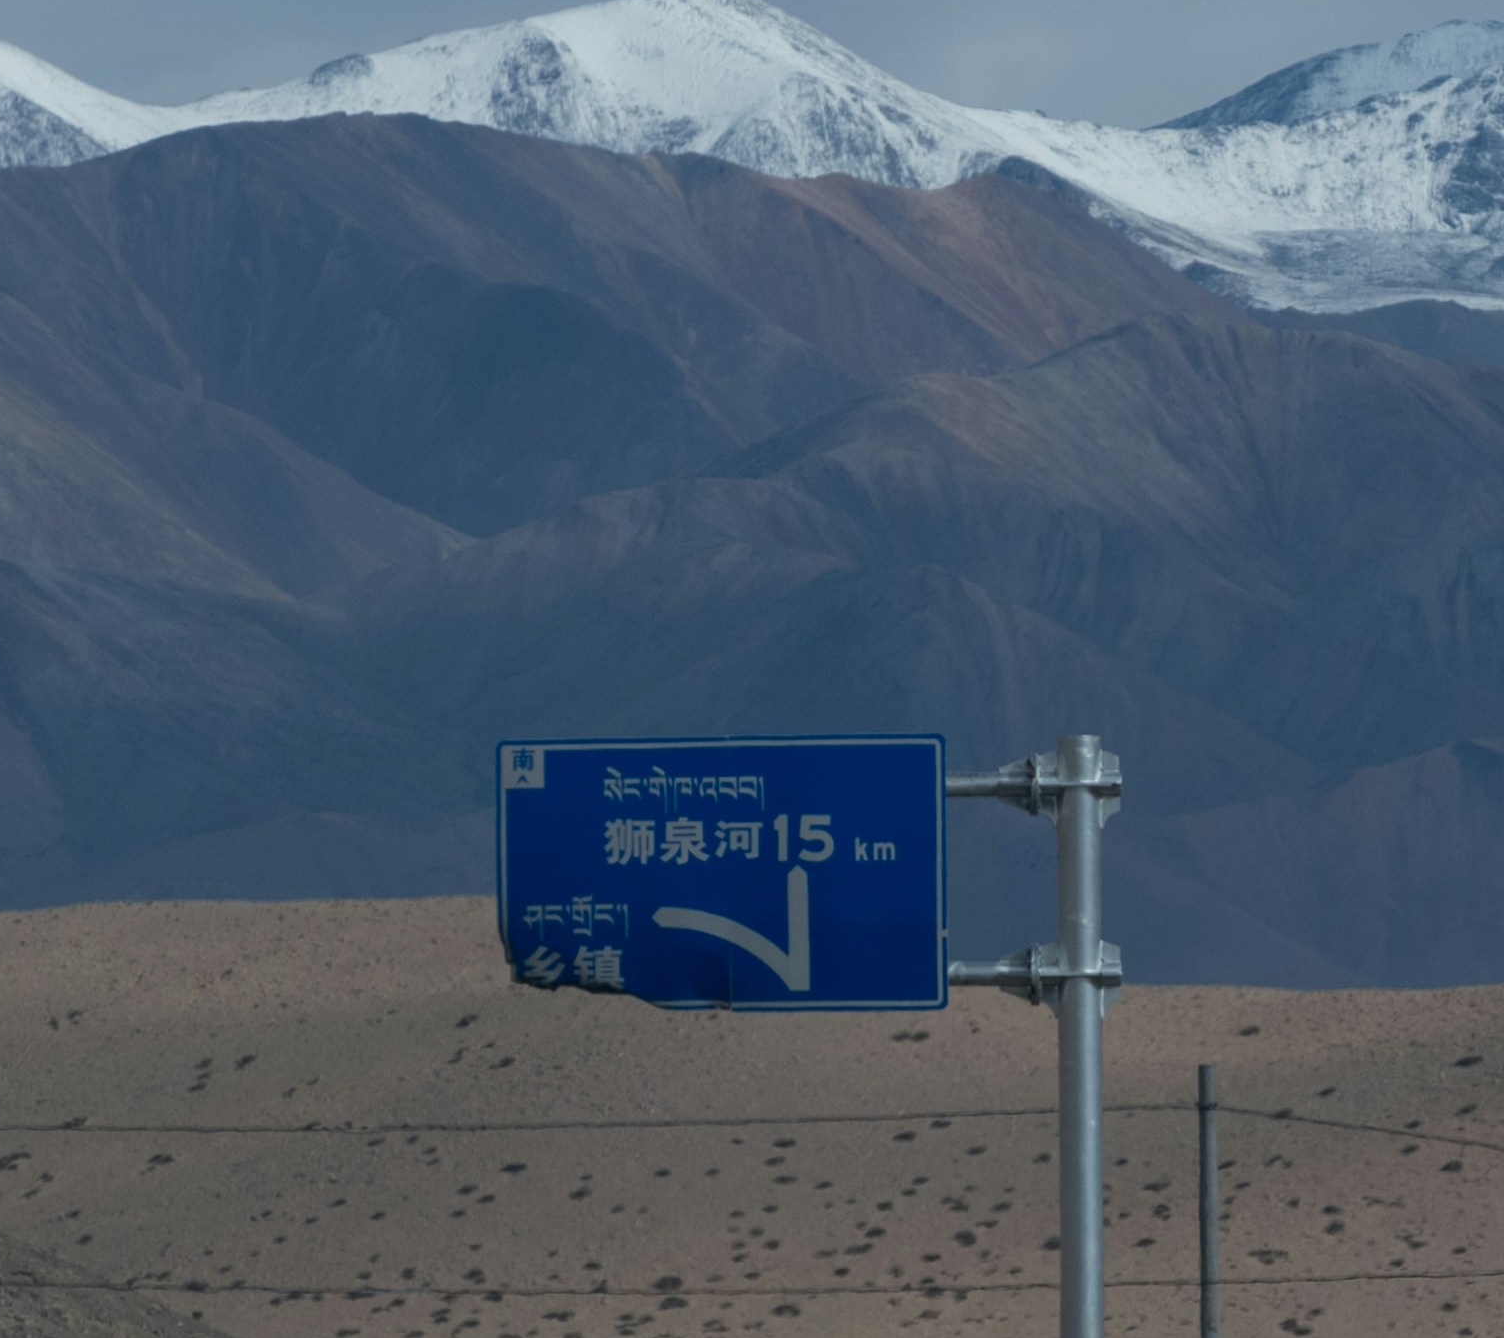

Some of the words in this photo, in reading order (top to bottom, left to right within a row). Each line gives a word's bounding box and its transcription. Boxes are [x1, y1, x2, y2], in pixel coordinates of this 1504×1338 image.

[512, 748, 535, 771] 南
[604, 817, 763, 865] 狮泉河
[773, 813, 835, 861] 15
[854, 837, 896, 861] km
[523, 946, 625, 989] 乡镇
